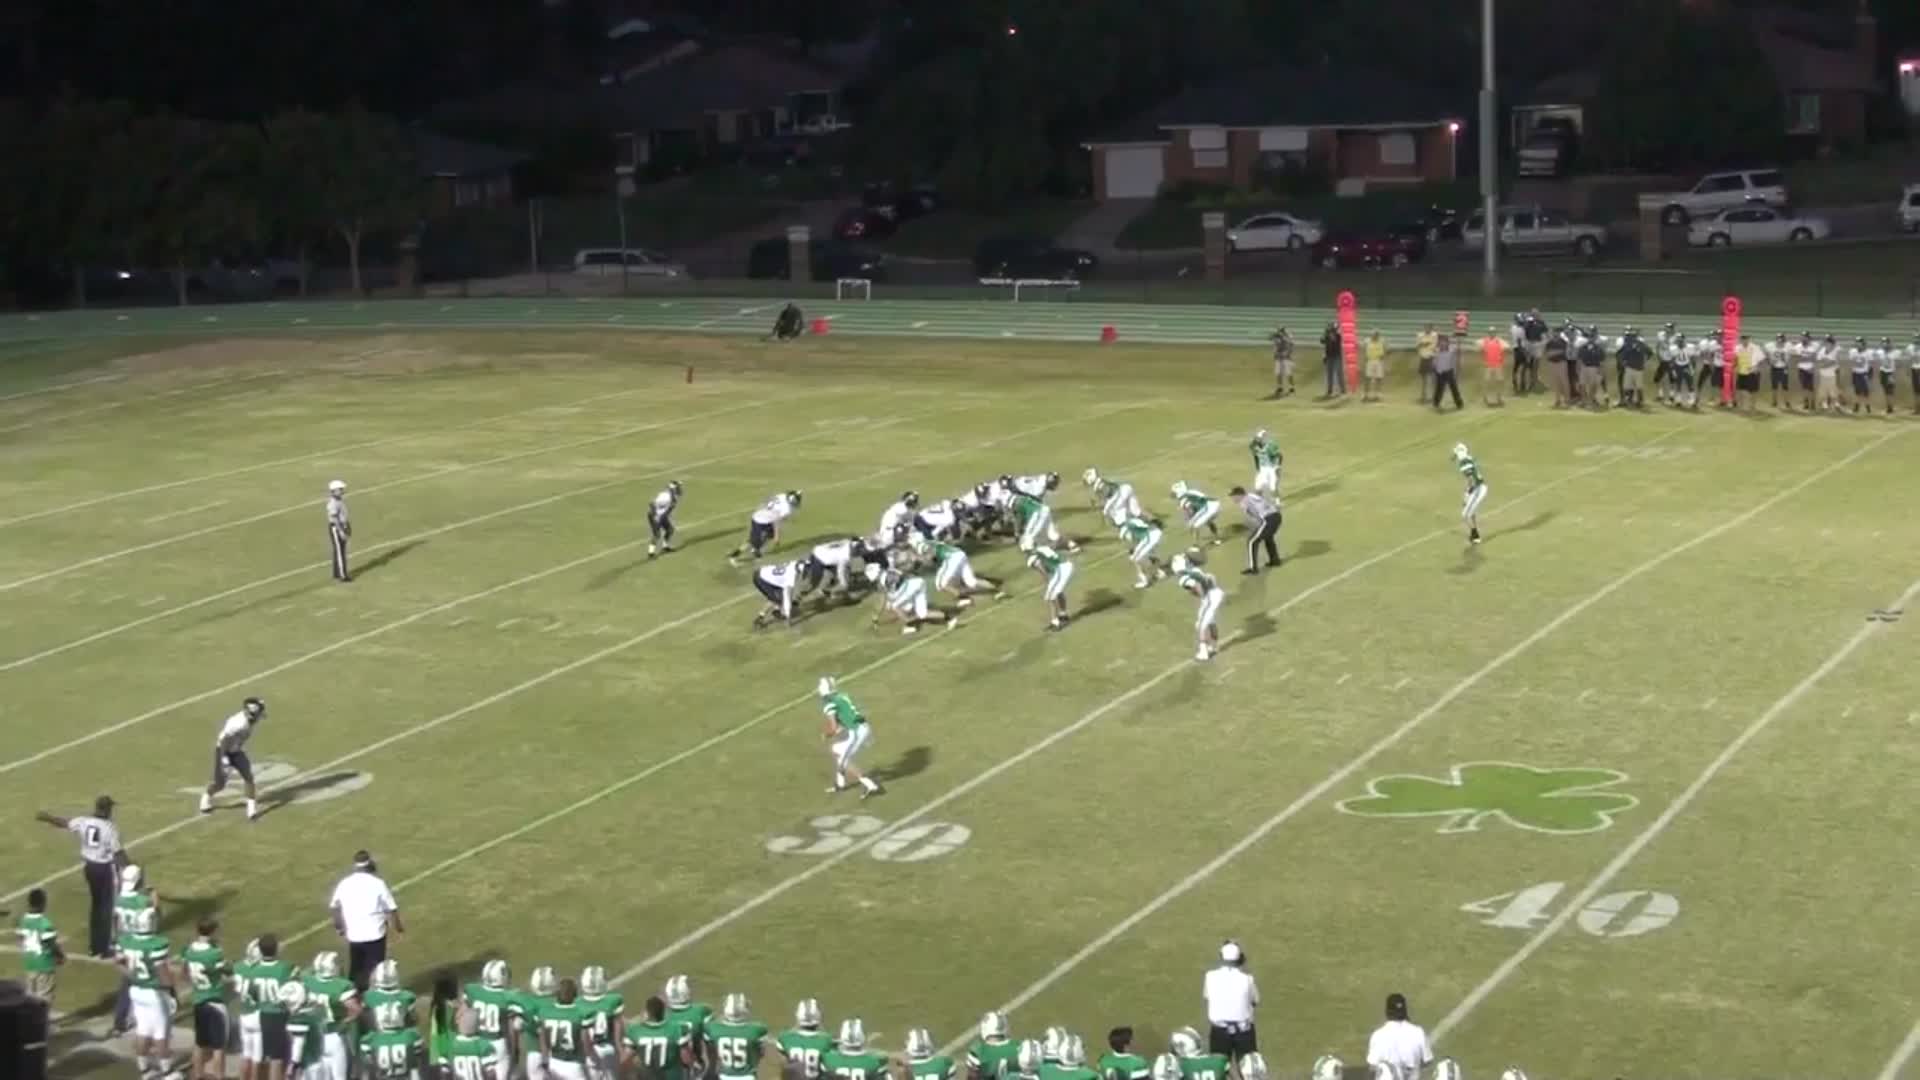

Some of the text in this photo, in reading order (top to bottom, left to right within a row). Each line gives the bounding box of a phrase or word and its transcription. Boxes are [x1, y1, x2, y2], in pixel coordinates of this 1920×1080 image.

[86, 825, 100, 848] L
[766, 815, 972, 862] 30
[1459, 881, 1680, 938] 40
[254, 978, 281, 1004] 70
[544, 1019, 574, 1050] 73
[638, 1037, 668, 1067] 77
[717, 1037, 748, 1068] 65
